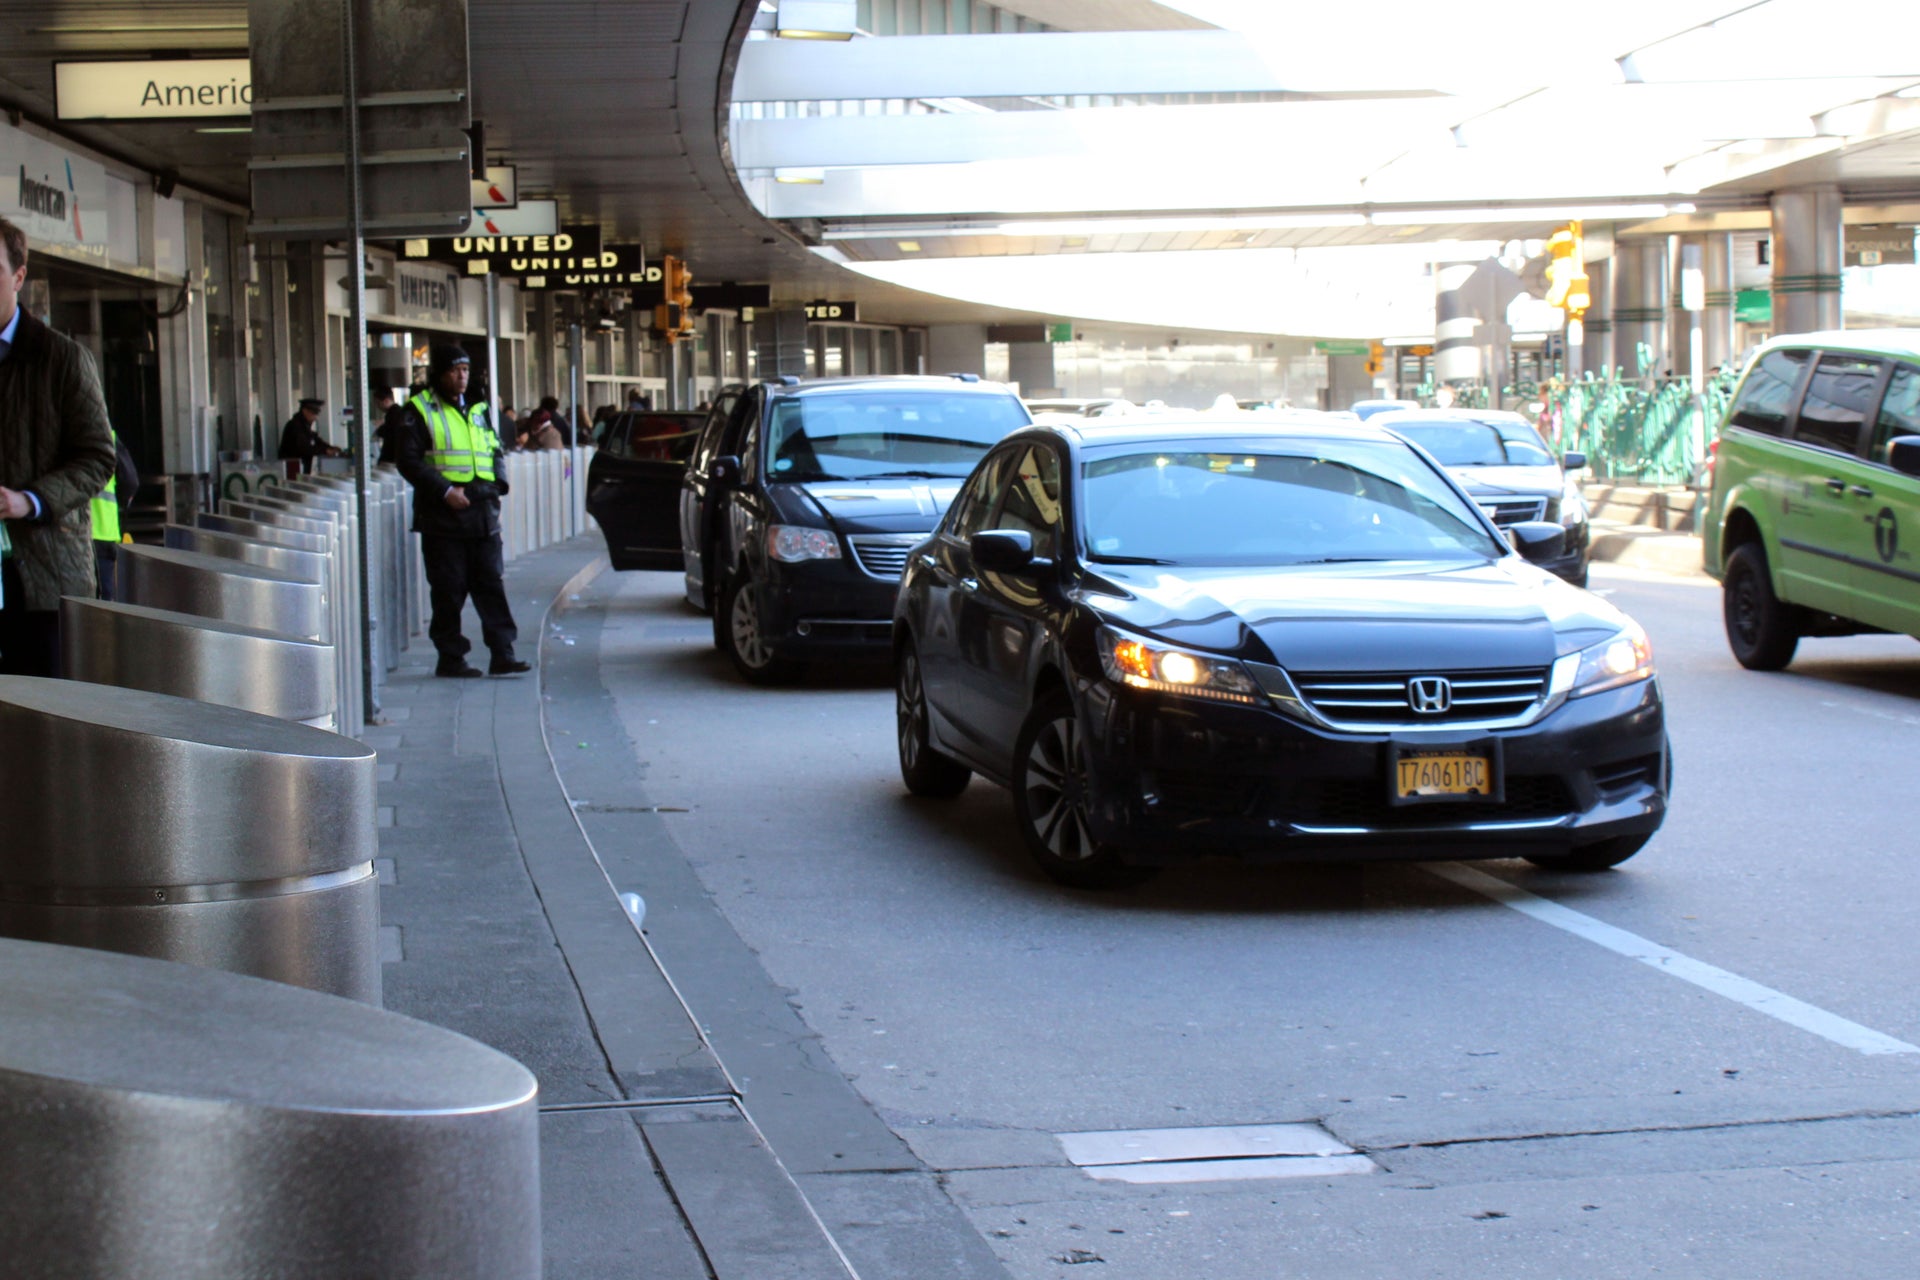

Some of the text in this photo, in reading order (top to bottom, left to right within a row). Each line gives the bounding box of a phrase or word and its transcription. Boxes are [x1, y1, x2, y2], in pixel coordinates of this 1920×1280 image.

[453, 233, 573, 253] UNITED
[401, 274, 447, 310] UNITED
[1400, 761, 1484, 788] T760618C
